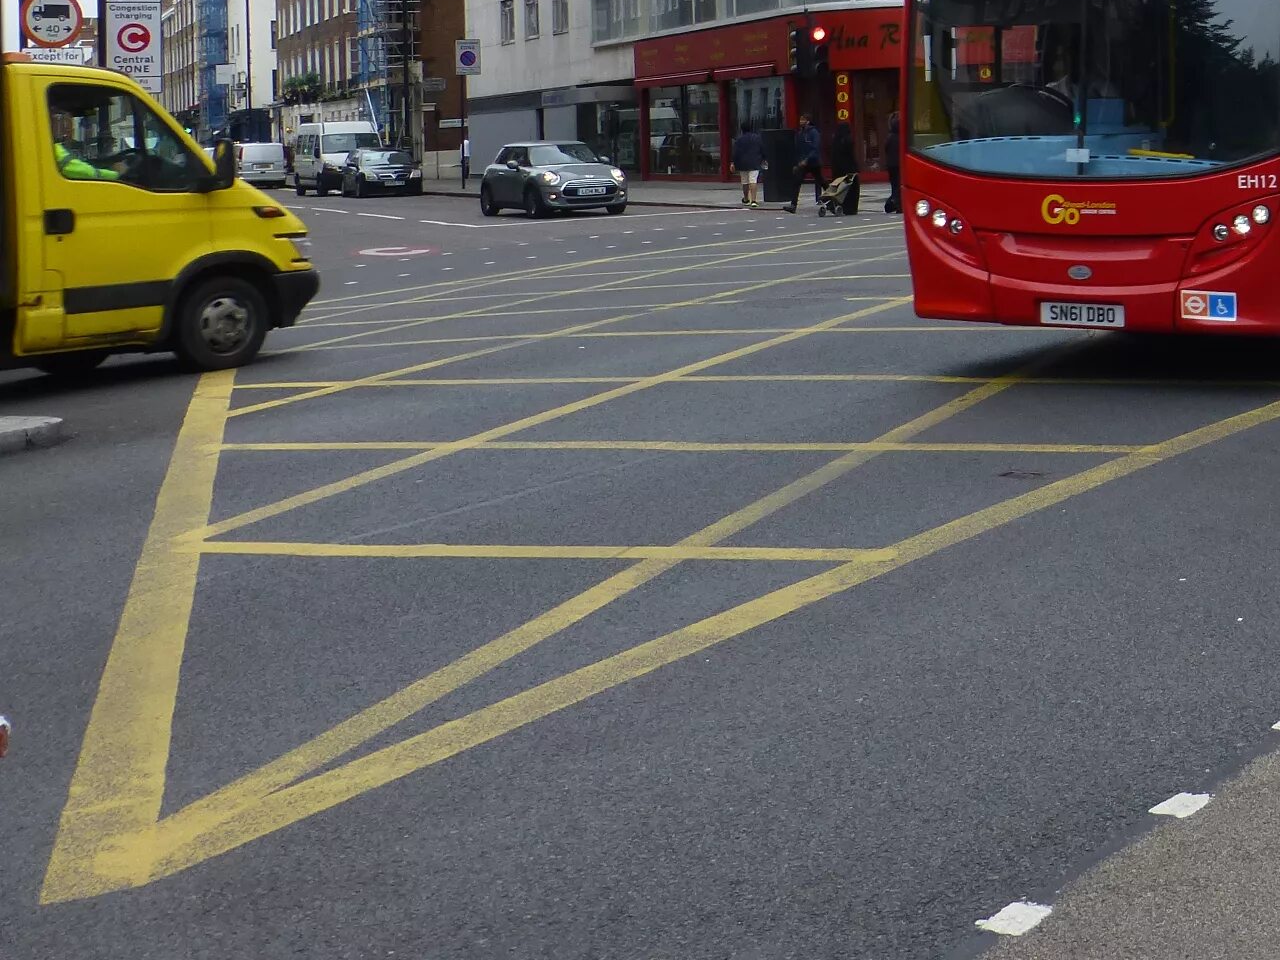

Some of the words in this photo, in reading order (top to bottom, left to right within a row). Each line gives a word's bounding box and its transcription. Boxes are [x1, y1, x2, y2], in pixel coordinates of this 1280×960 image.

[109, 4, 158, 12] Congestion
[114, 12, 153, 20] charging
[45, 25, 60, 33] 40
[26, 51, 62, 61] xcept
[65, 52, 79, 60] for
[114, 55, 154, 64] Central
[1237, 174, 1278, 189] EH12
[1041, 193, 1080, 225] Go
[1050, 304, 1083, 321] SN61
[1086, 307, 1116, 323] DBO
